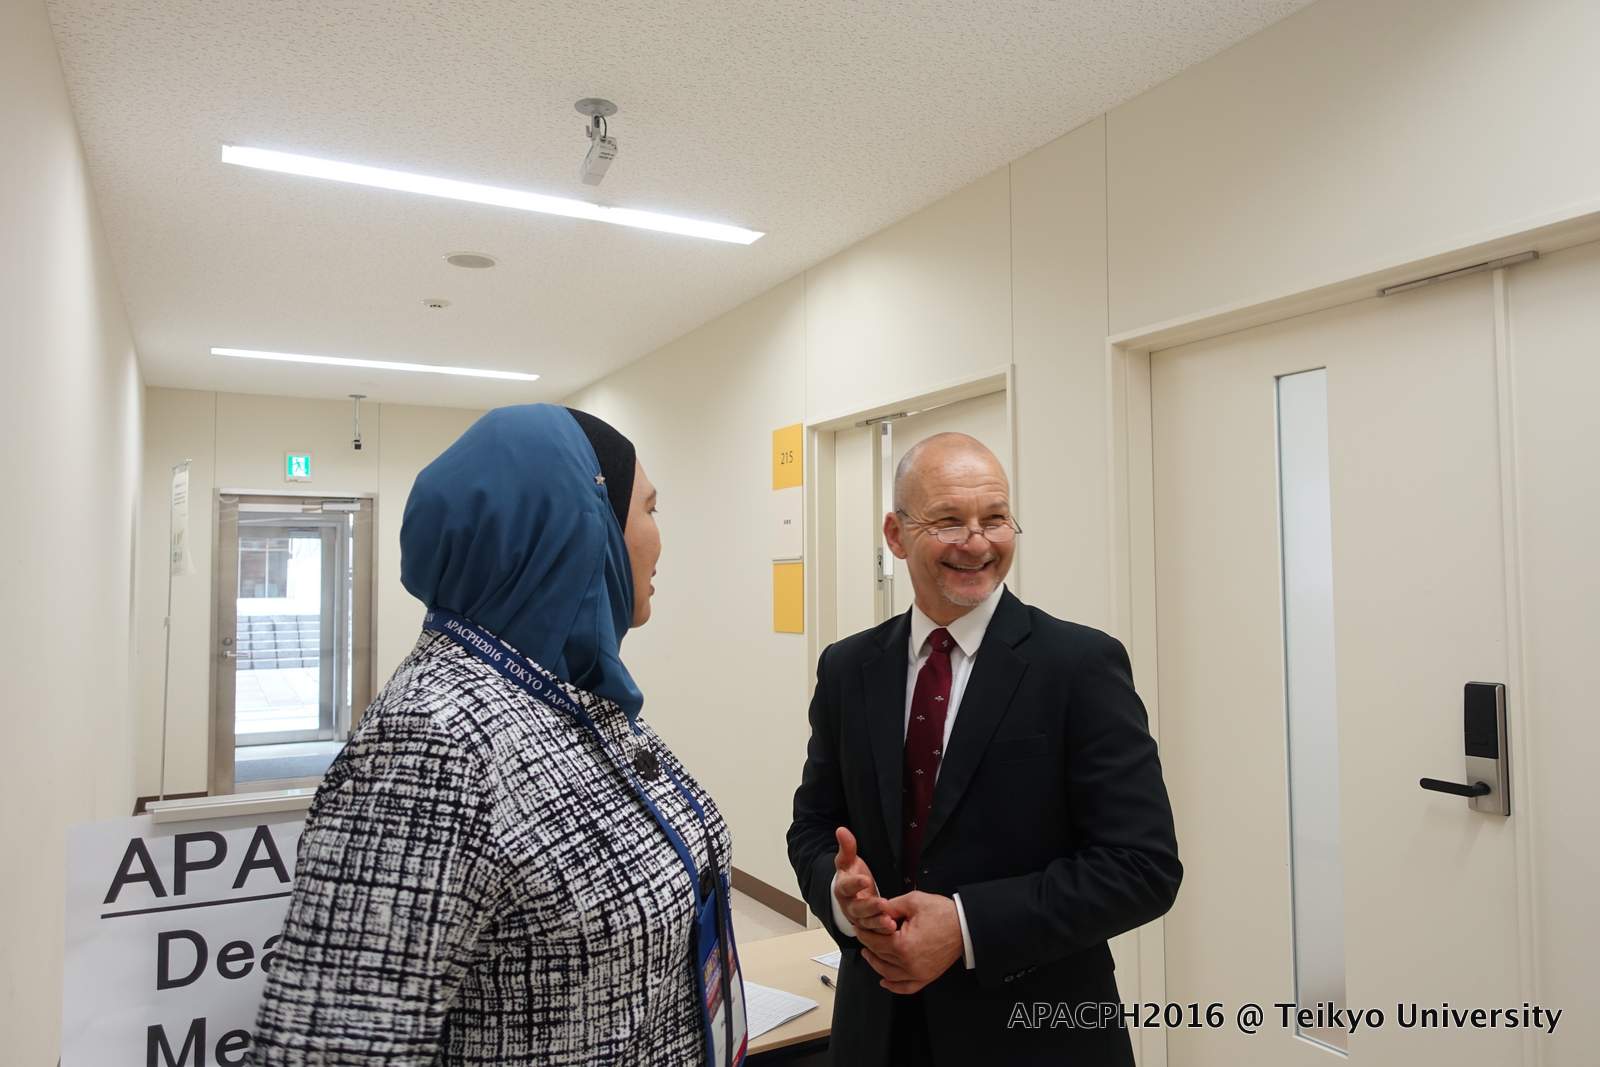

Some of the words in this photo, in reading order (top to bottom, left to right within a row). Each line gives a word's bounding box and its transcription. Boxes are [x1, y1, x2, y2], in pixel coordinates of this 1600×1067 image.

[780, 450, 794, 465] 215
[444, 619, 501, 662] APACPH2016
[504, 657, 543, 691] TOKYO
[544, 689, 580, 716] JAPAN
[103, 824, 304, 904] APA
[146, 1017, 252, 1067] Me
